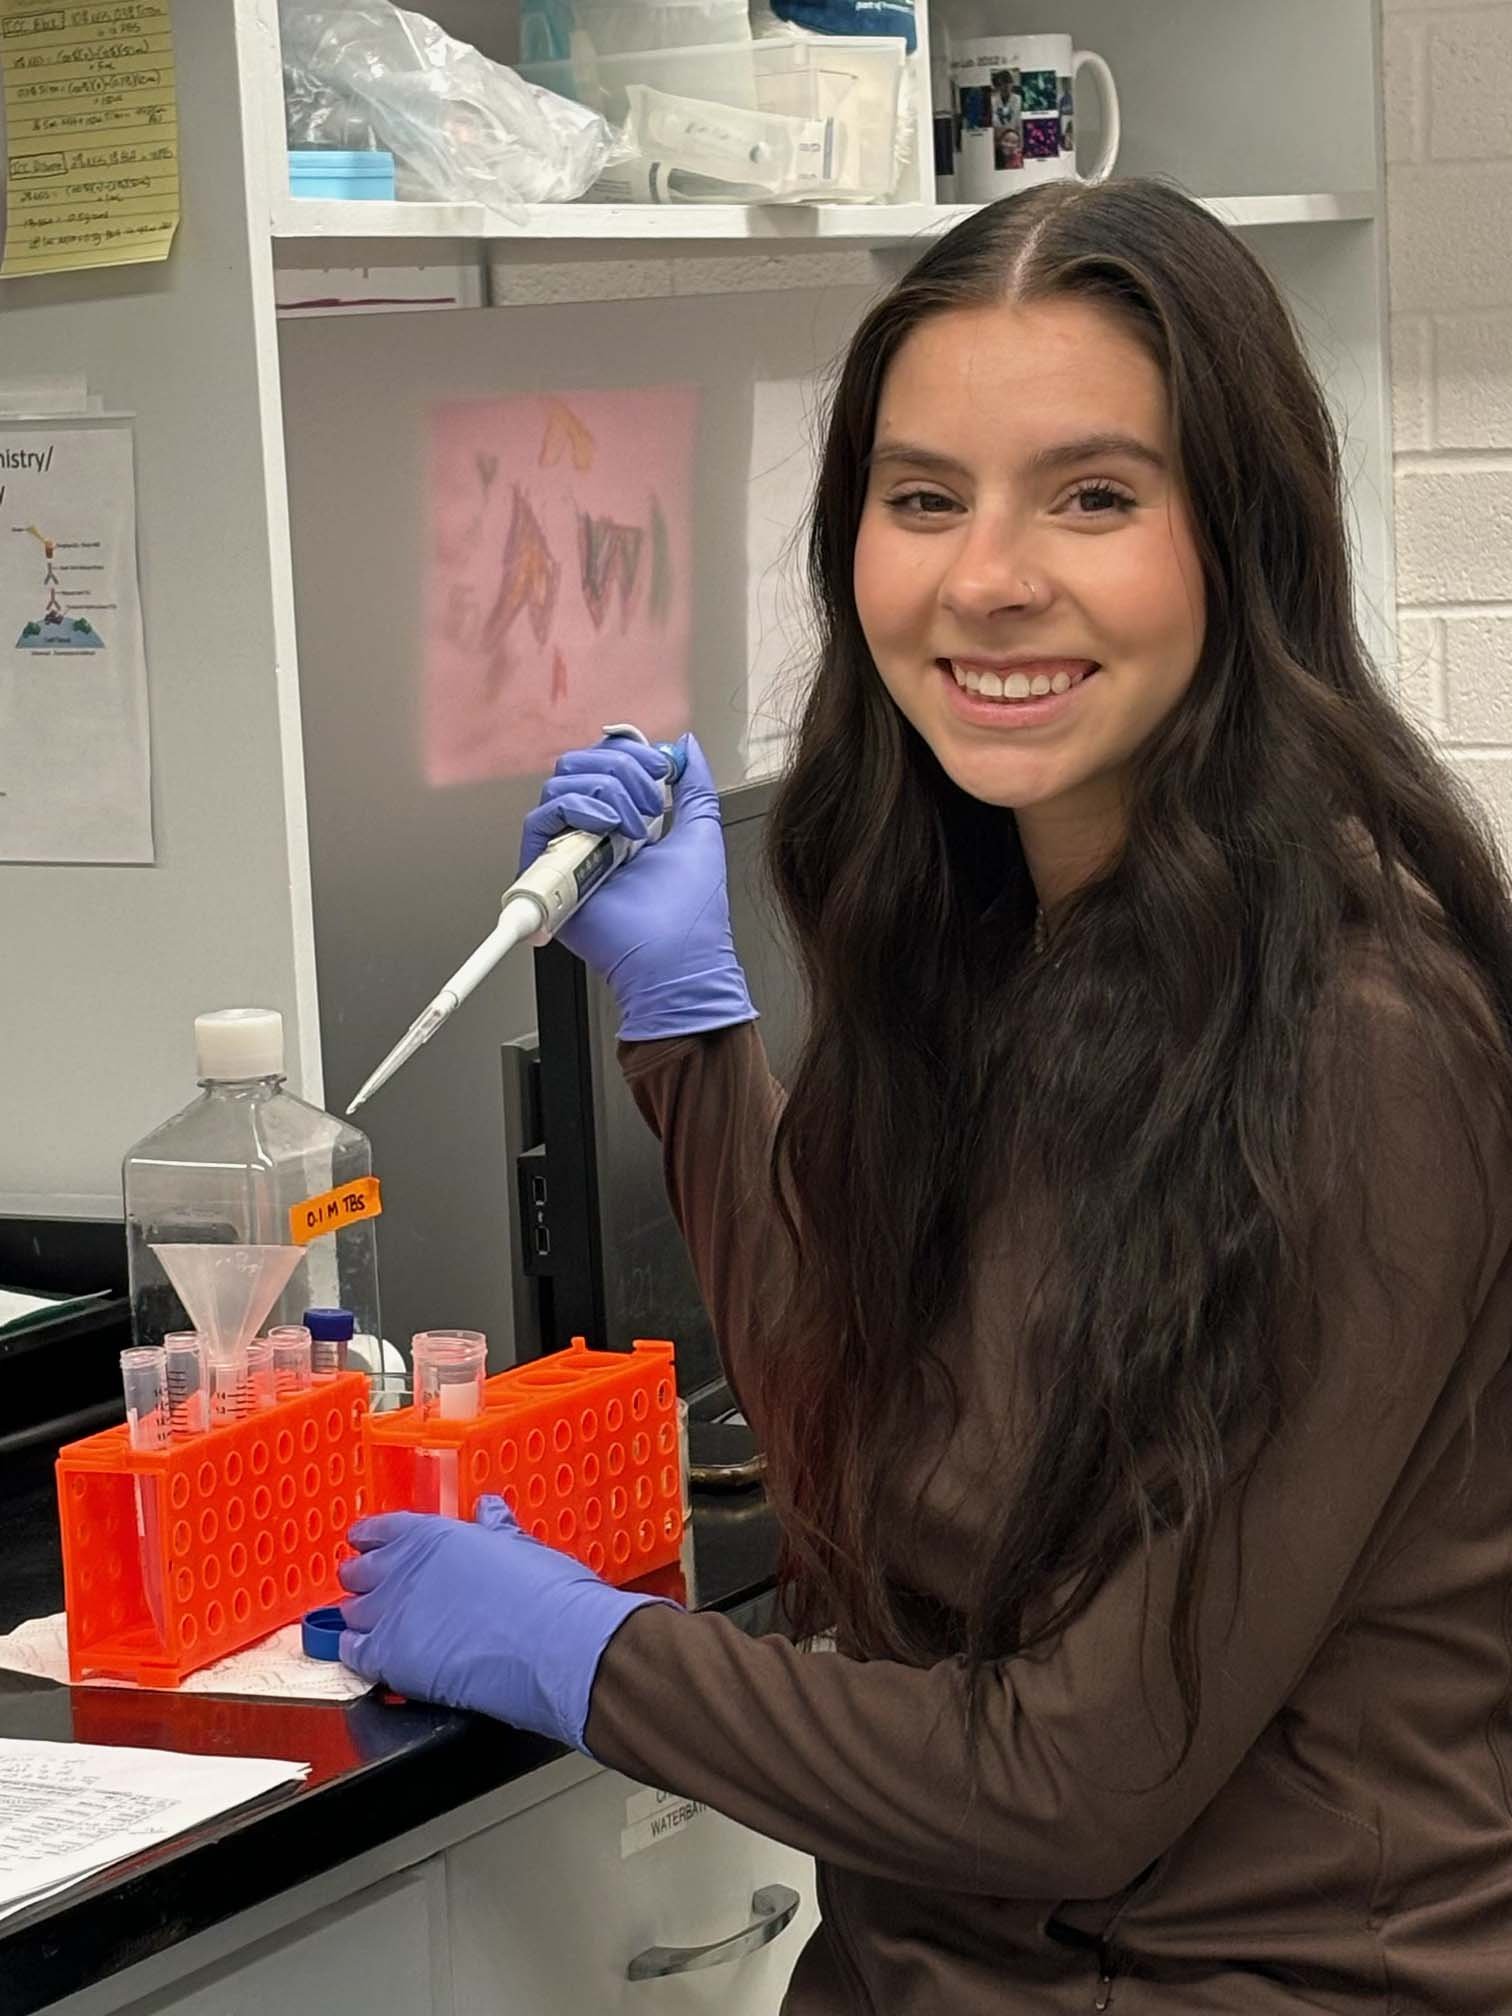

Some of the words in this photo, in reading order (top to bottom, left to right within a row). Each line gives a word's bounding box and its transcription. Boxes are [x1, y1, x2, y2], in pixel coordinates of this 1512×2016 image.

[306, 1207, 322, 1228] 0.1
[327, 1201, 339, 1218] M
[342, 1193, 366, 1213] TBS
